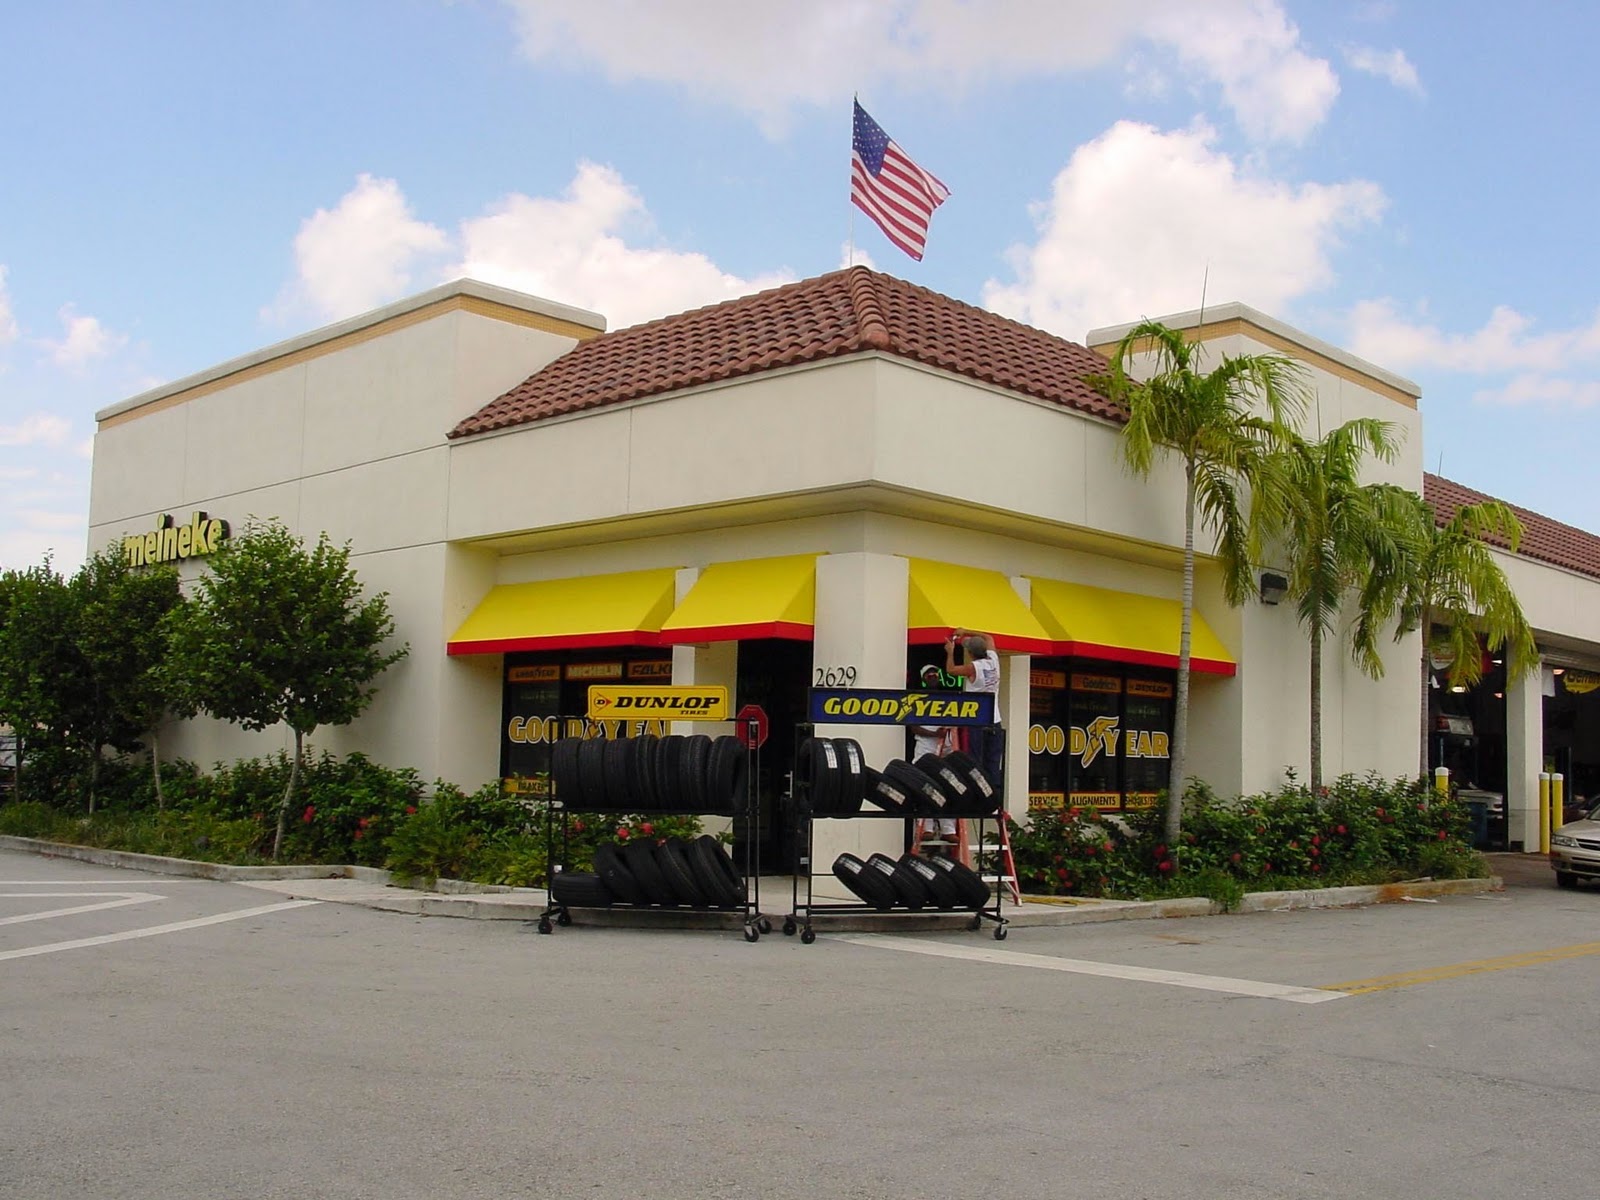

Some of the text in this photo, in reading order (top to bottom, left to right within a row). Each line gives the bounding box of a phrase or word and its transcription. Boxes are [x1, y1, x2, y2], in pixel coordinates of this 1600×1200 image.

[124, 511, 229, 567] meineke
[568, 664, 622, 677] MICHELIN
[815, 666, 857, 687] 2629
[614, 697, 720, 708] DUNLOP
[1071, 796, 1116, 806] ALIGNMENTS
